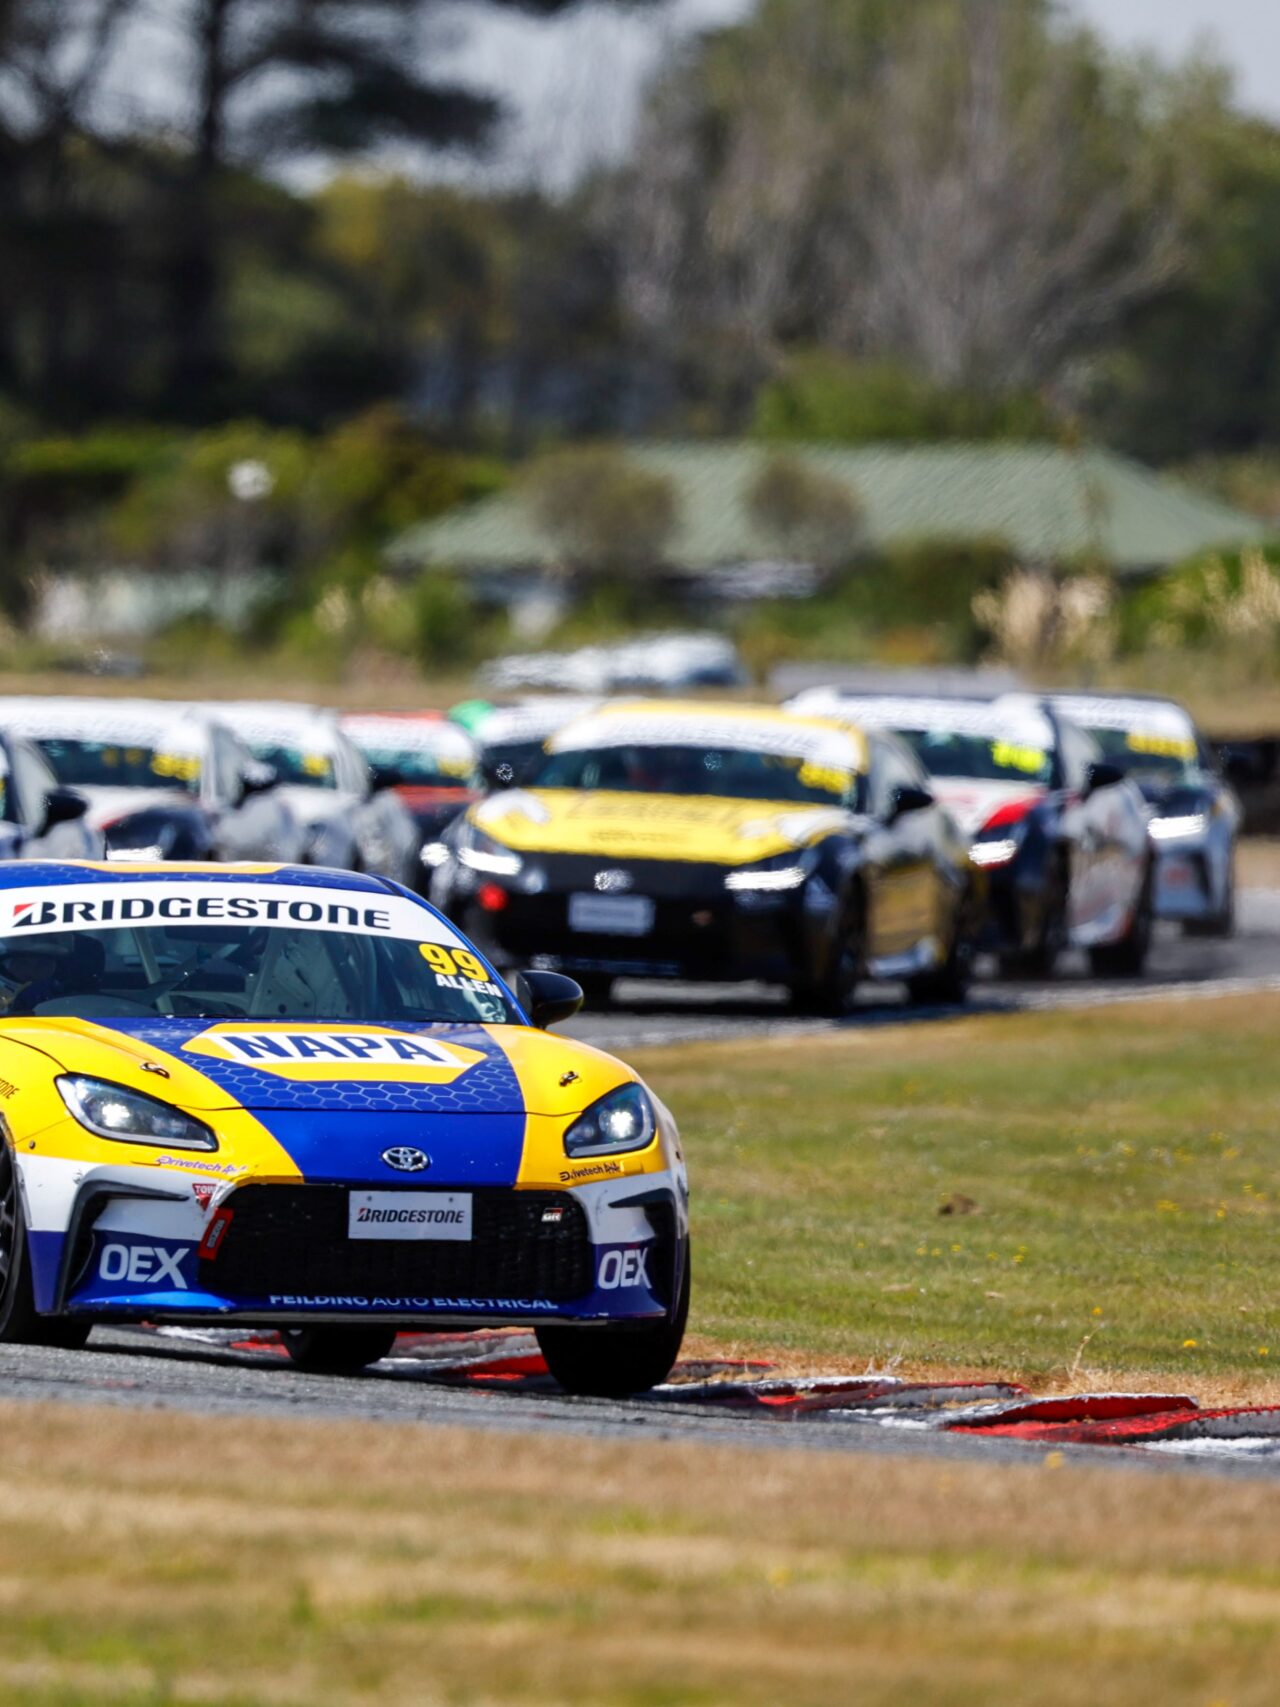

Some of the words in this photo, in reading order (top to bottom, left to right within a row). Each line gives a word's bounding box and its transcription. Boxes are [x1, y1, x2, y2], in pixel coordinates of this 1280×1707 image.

[11, 897, 391, 930] BRIDGESTONE
[418, 943, 489, 982] 99
[435, 973, 504, 998] ALLEN
[223, 1035, 446, 1062] NAPA
[357, 1207, 465, 1224] BRIDGESTONE
[99, 1243, 190, 1290] OEX
[598, 1248, 653, 1290] OEX
[269, 1294, 369, 1306] FEILDING
[371, 1296, 430, 1307] AUTO
[433, 1297, 559, 1310] ELECTRICAL
